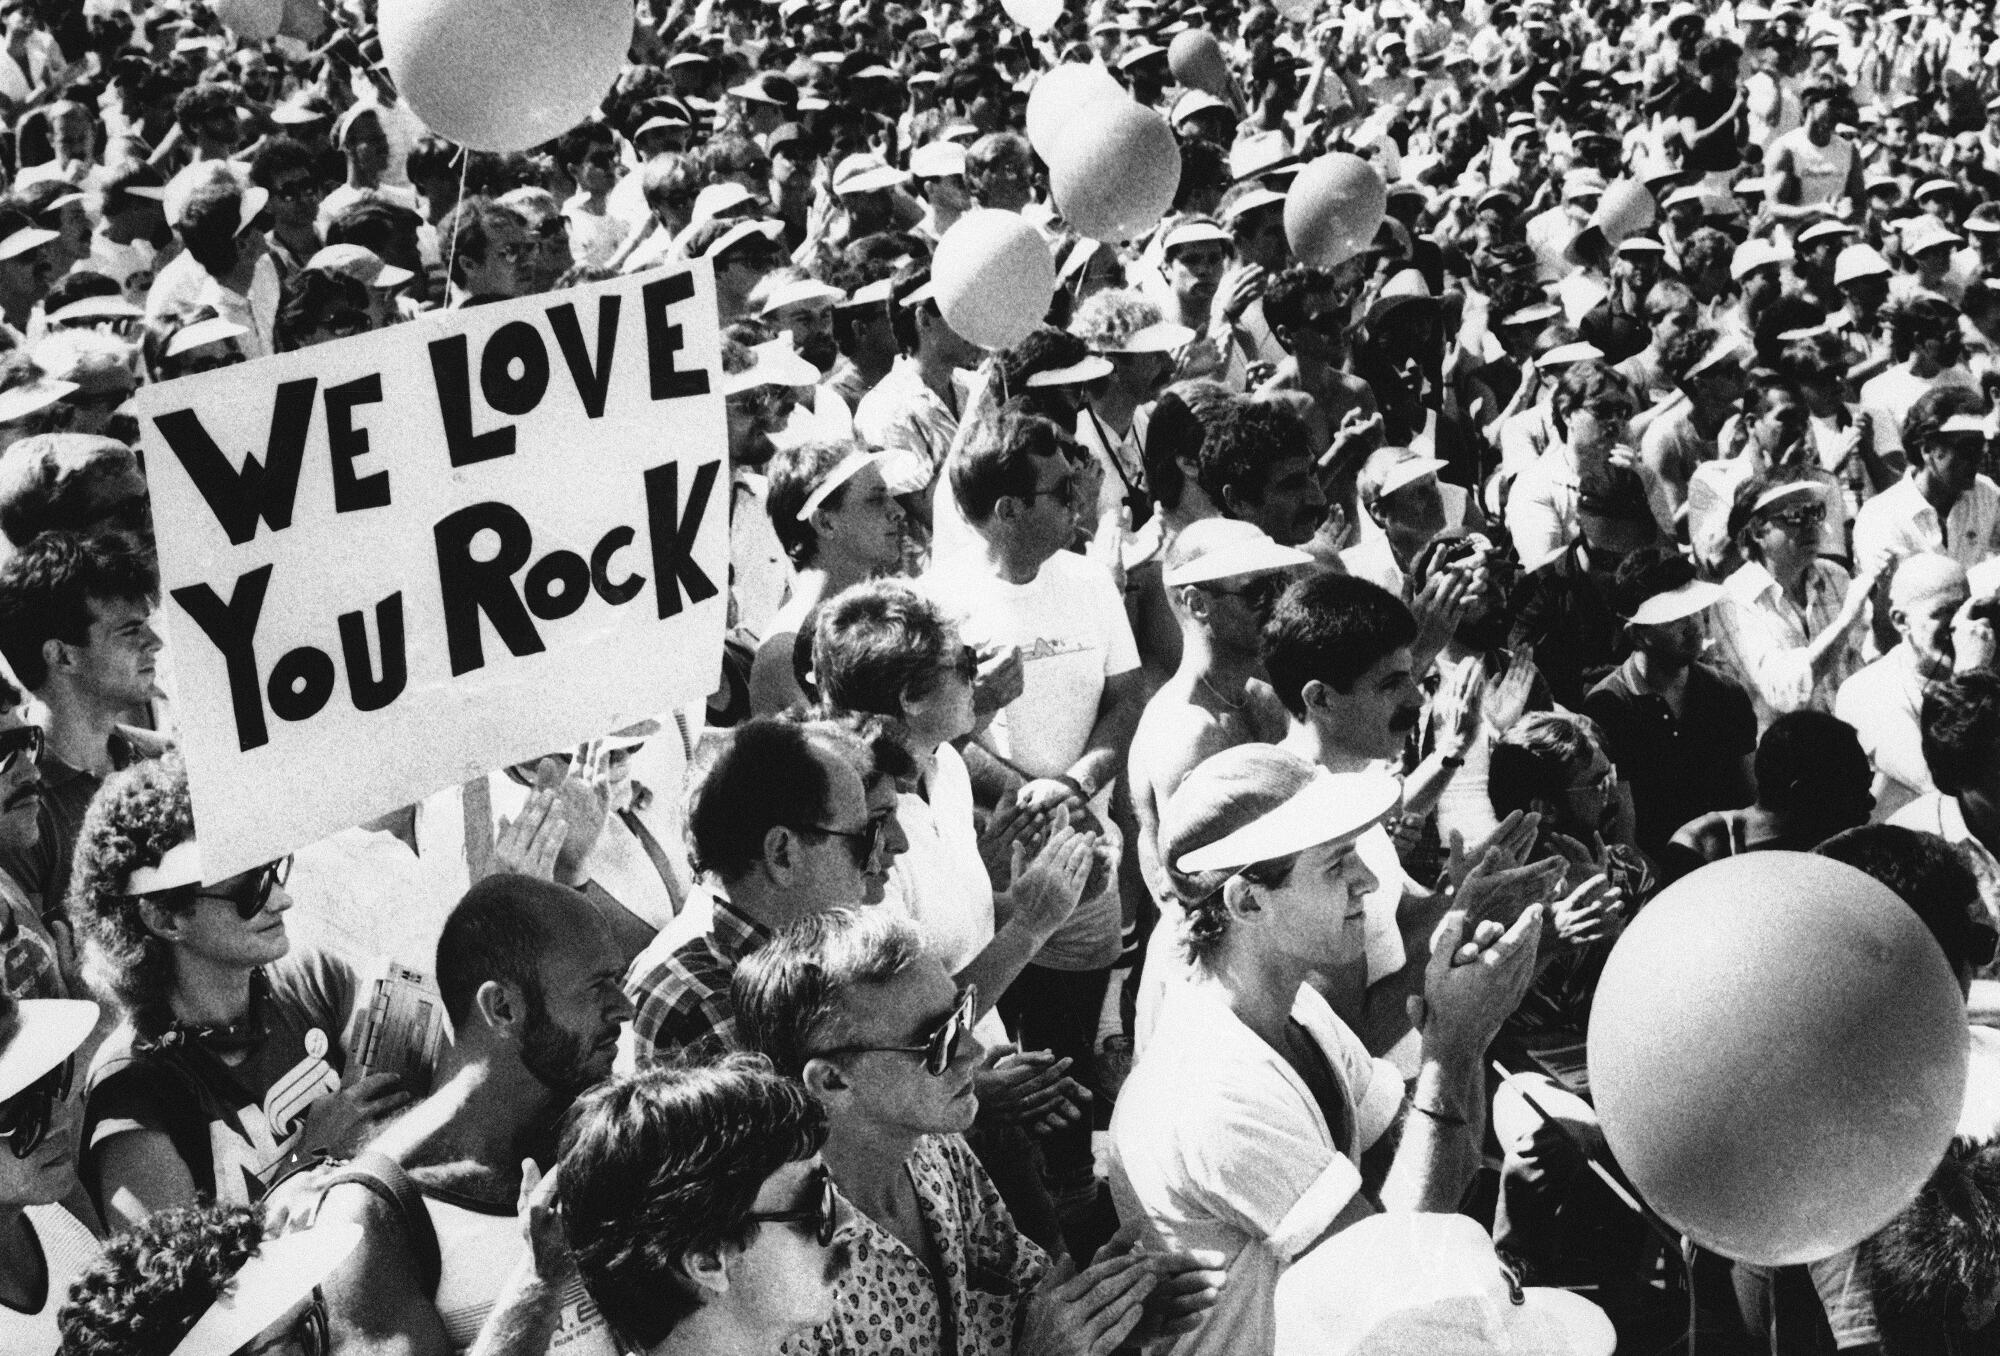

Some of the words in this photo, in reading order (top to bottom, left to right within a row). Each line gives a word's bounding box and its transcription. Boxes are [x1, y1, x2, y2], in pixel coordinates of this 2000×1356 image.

[152, 372, 392, 546] WE
[427, 270, 710, 468] LOVE
[170, 563, 408, 752] YOU
[433, 460, 721, 677] ROCK
